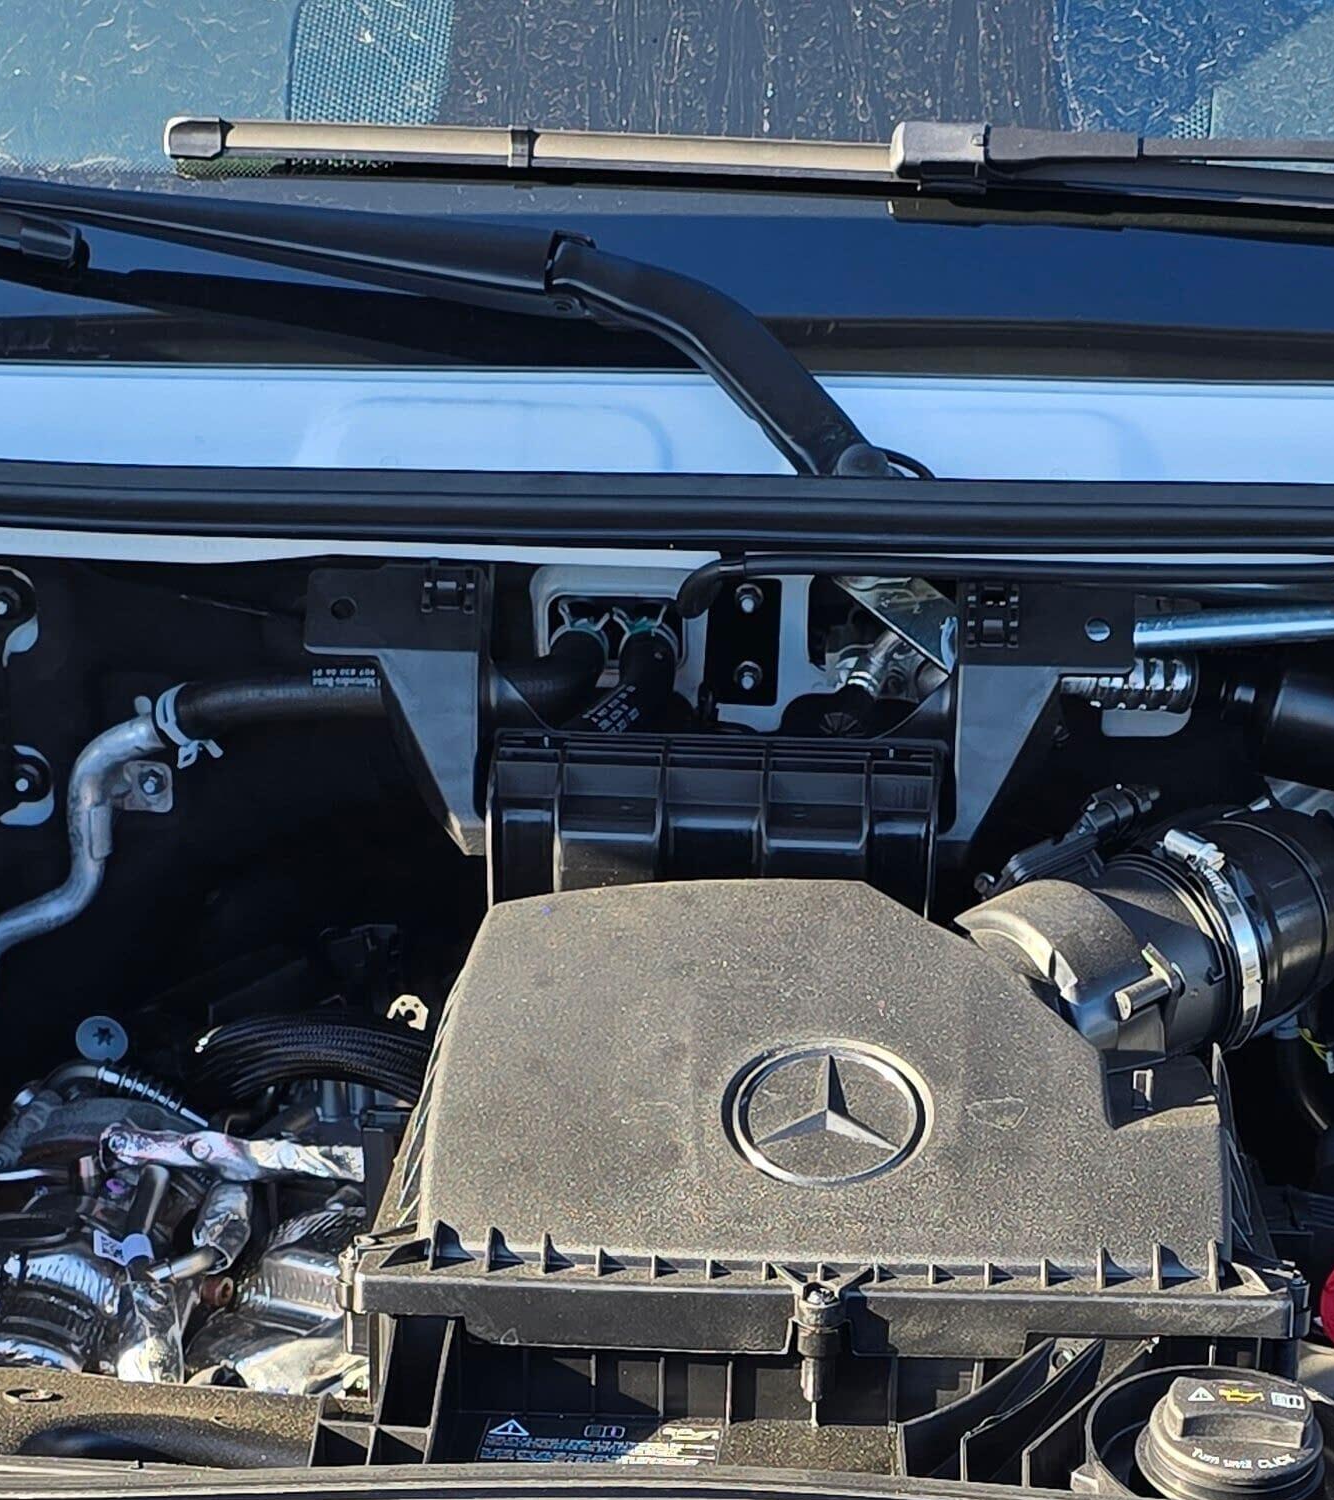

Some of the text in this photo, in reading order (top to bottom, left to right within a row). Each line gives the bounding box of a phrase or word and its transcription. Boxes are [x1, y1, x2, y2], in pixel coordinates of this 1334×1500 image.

[1192, 1447, 1297, 1470] Turn until CLICK
